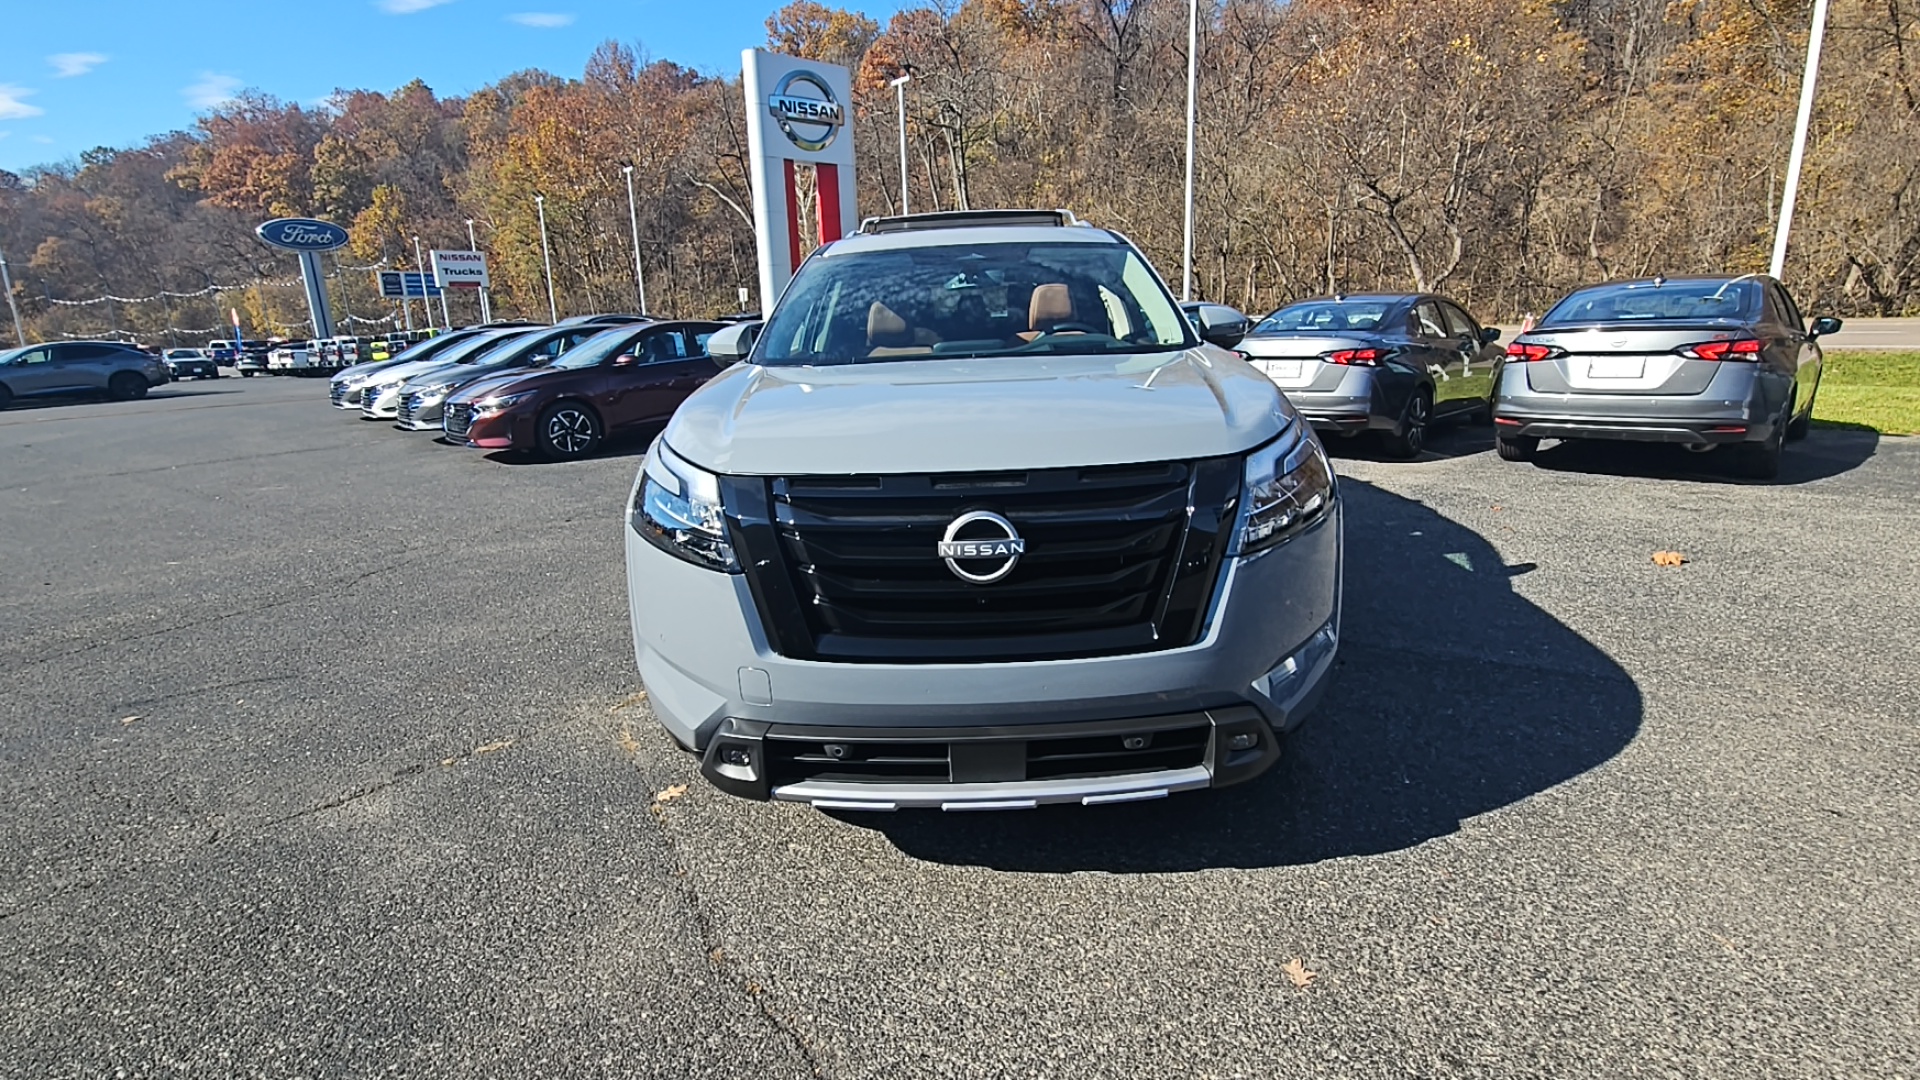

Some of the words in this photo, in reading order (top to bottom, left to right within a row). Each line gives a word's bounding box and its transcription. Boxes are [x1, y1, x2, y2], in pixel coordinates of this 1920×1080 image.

[779, 99, 839, 120] NISSAN
[281, 223, 331, 243] Ford
[439, 253, 481, 261] NISSAN
[442, 267, 483, 275] Trucks
[941, 542, 1024, 556] NISSAN
